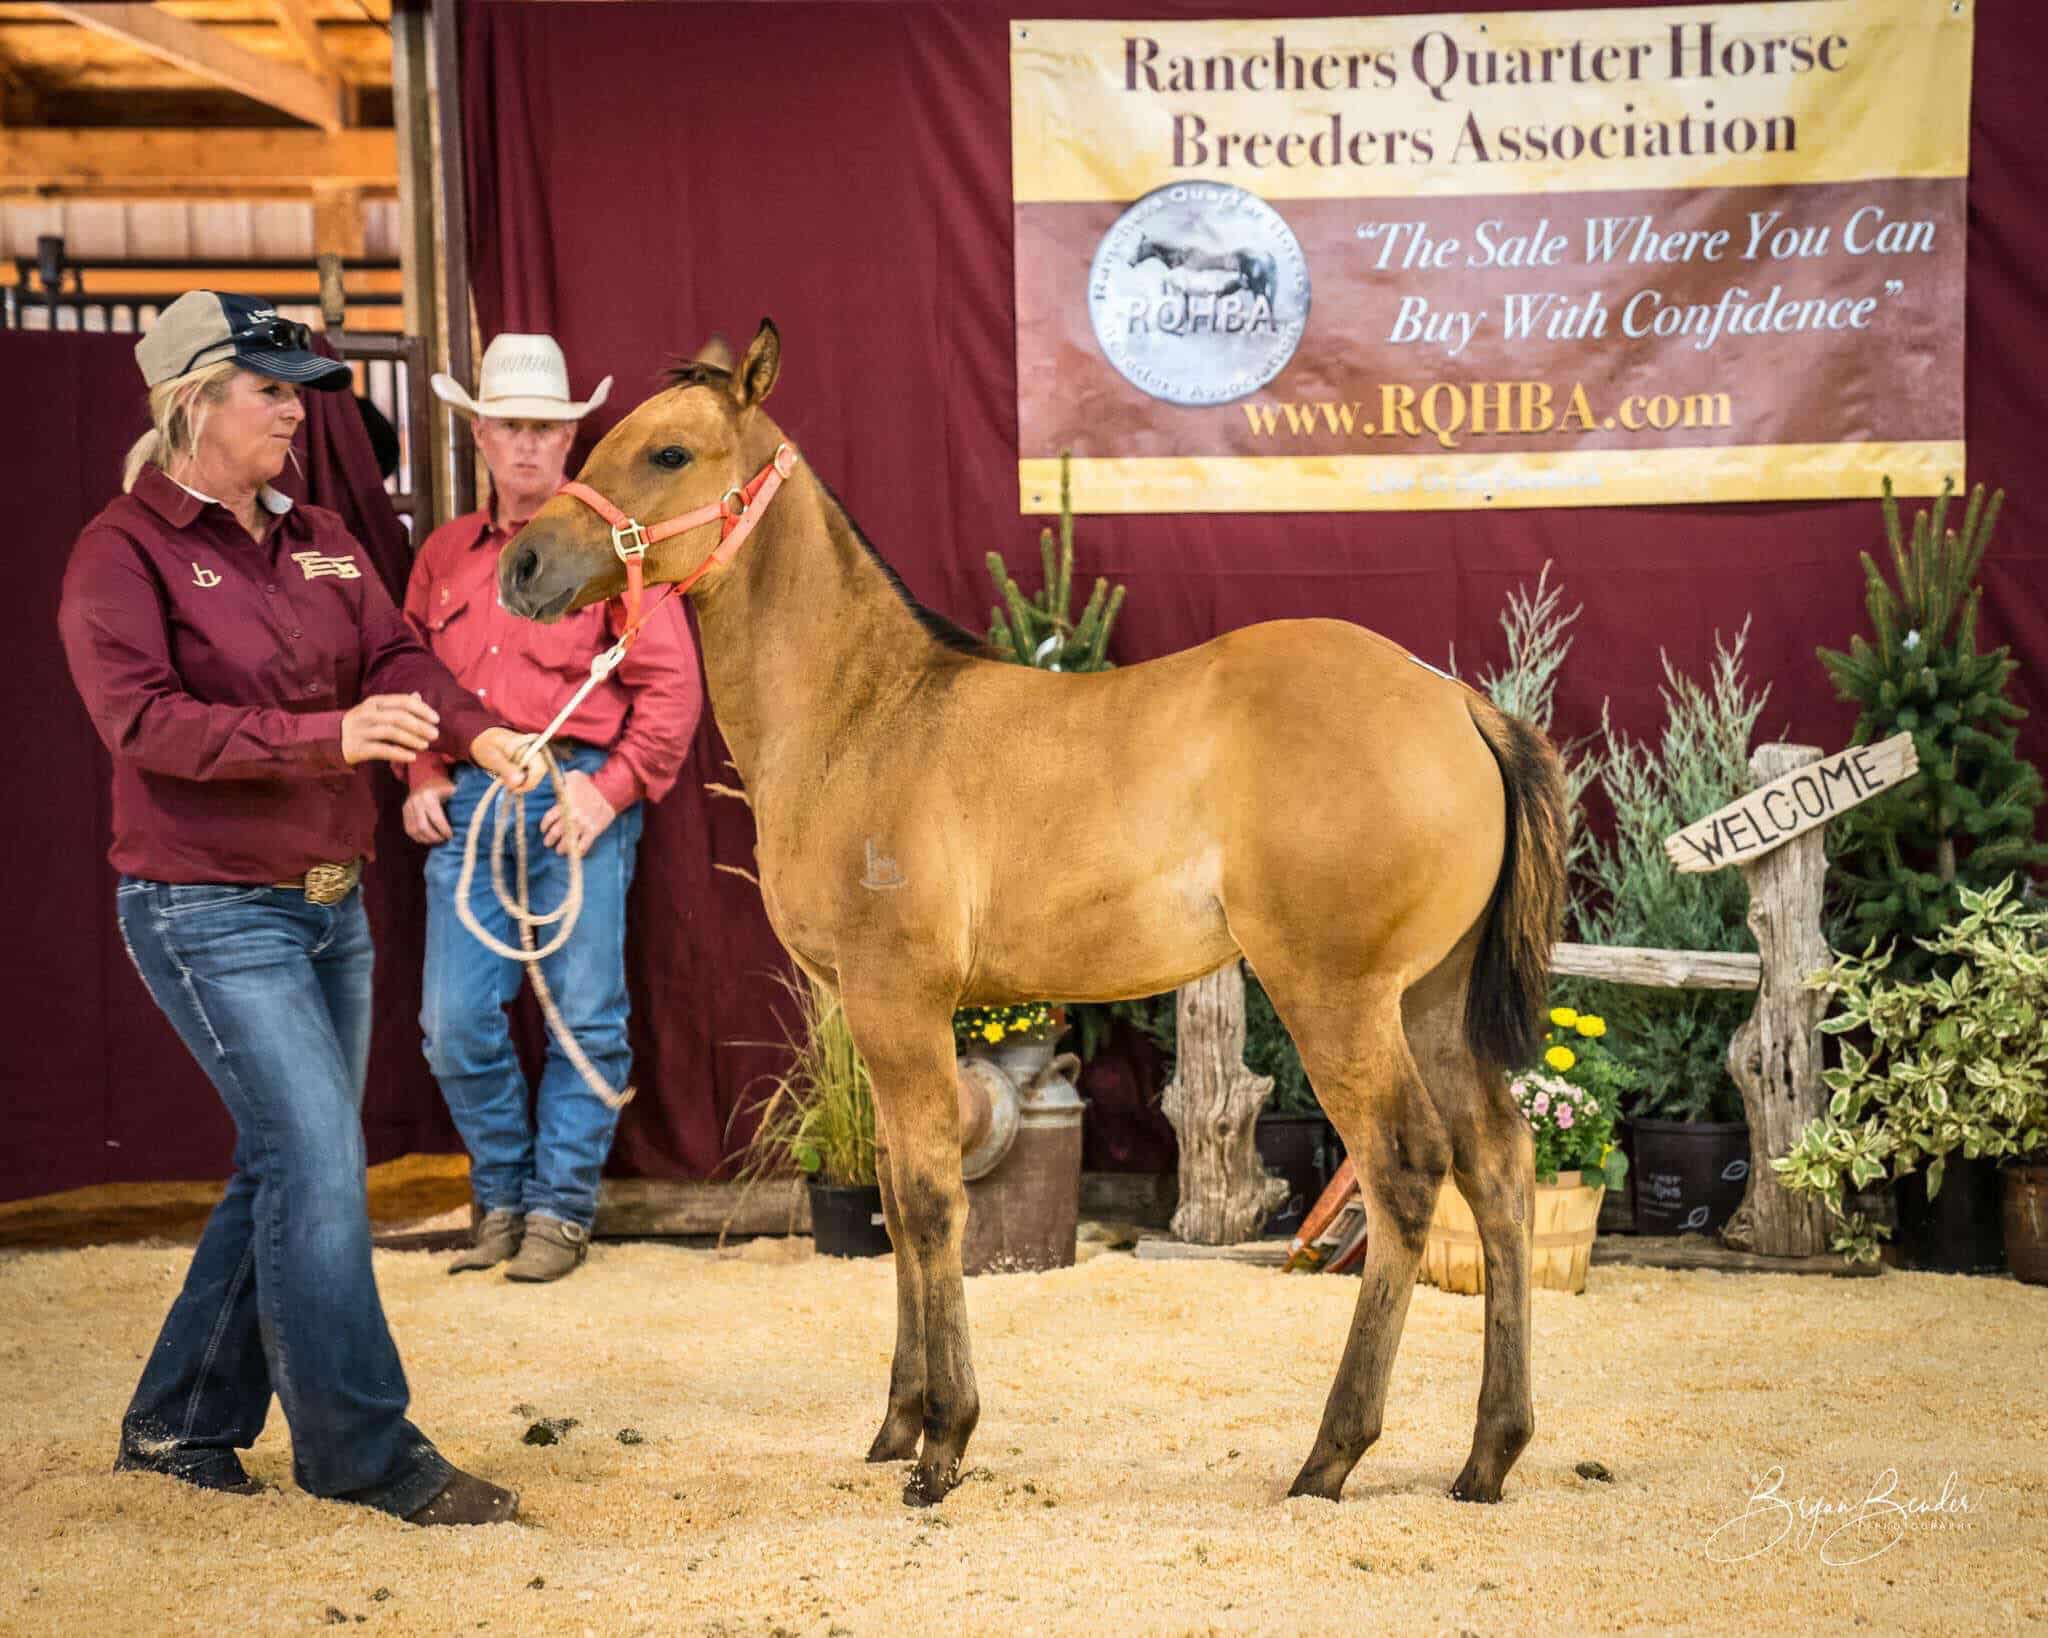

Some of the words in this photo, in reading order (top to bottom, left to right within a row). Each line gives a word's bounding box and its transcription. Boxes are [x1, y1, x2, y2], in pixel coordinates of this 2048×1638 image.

[1123, 35, 1397, 93] Ranchers
[1411, 30, 1652, 101] Quarter
[1666, 21, 1848, 79] Horse
[1172, 112, 1434, 168] Breeders
[1452, 100, 1797, 165] Association
[1467, 219, 1568, 268] Sale
[1584, 214, 1729, 264] Where
[1740, 210, 1831, 260] You
[1843, 205, 1936, 255] Can
[1128, 293, 1277, 337] RQHBA
[1387, 295, 1486, 358] Buy
[1502, 292, 1607, 341] With
[1244, 380, 1732, 447] www.RQHBA.com
[1680, 751, 1883, 865] WELCOME
